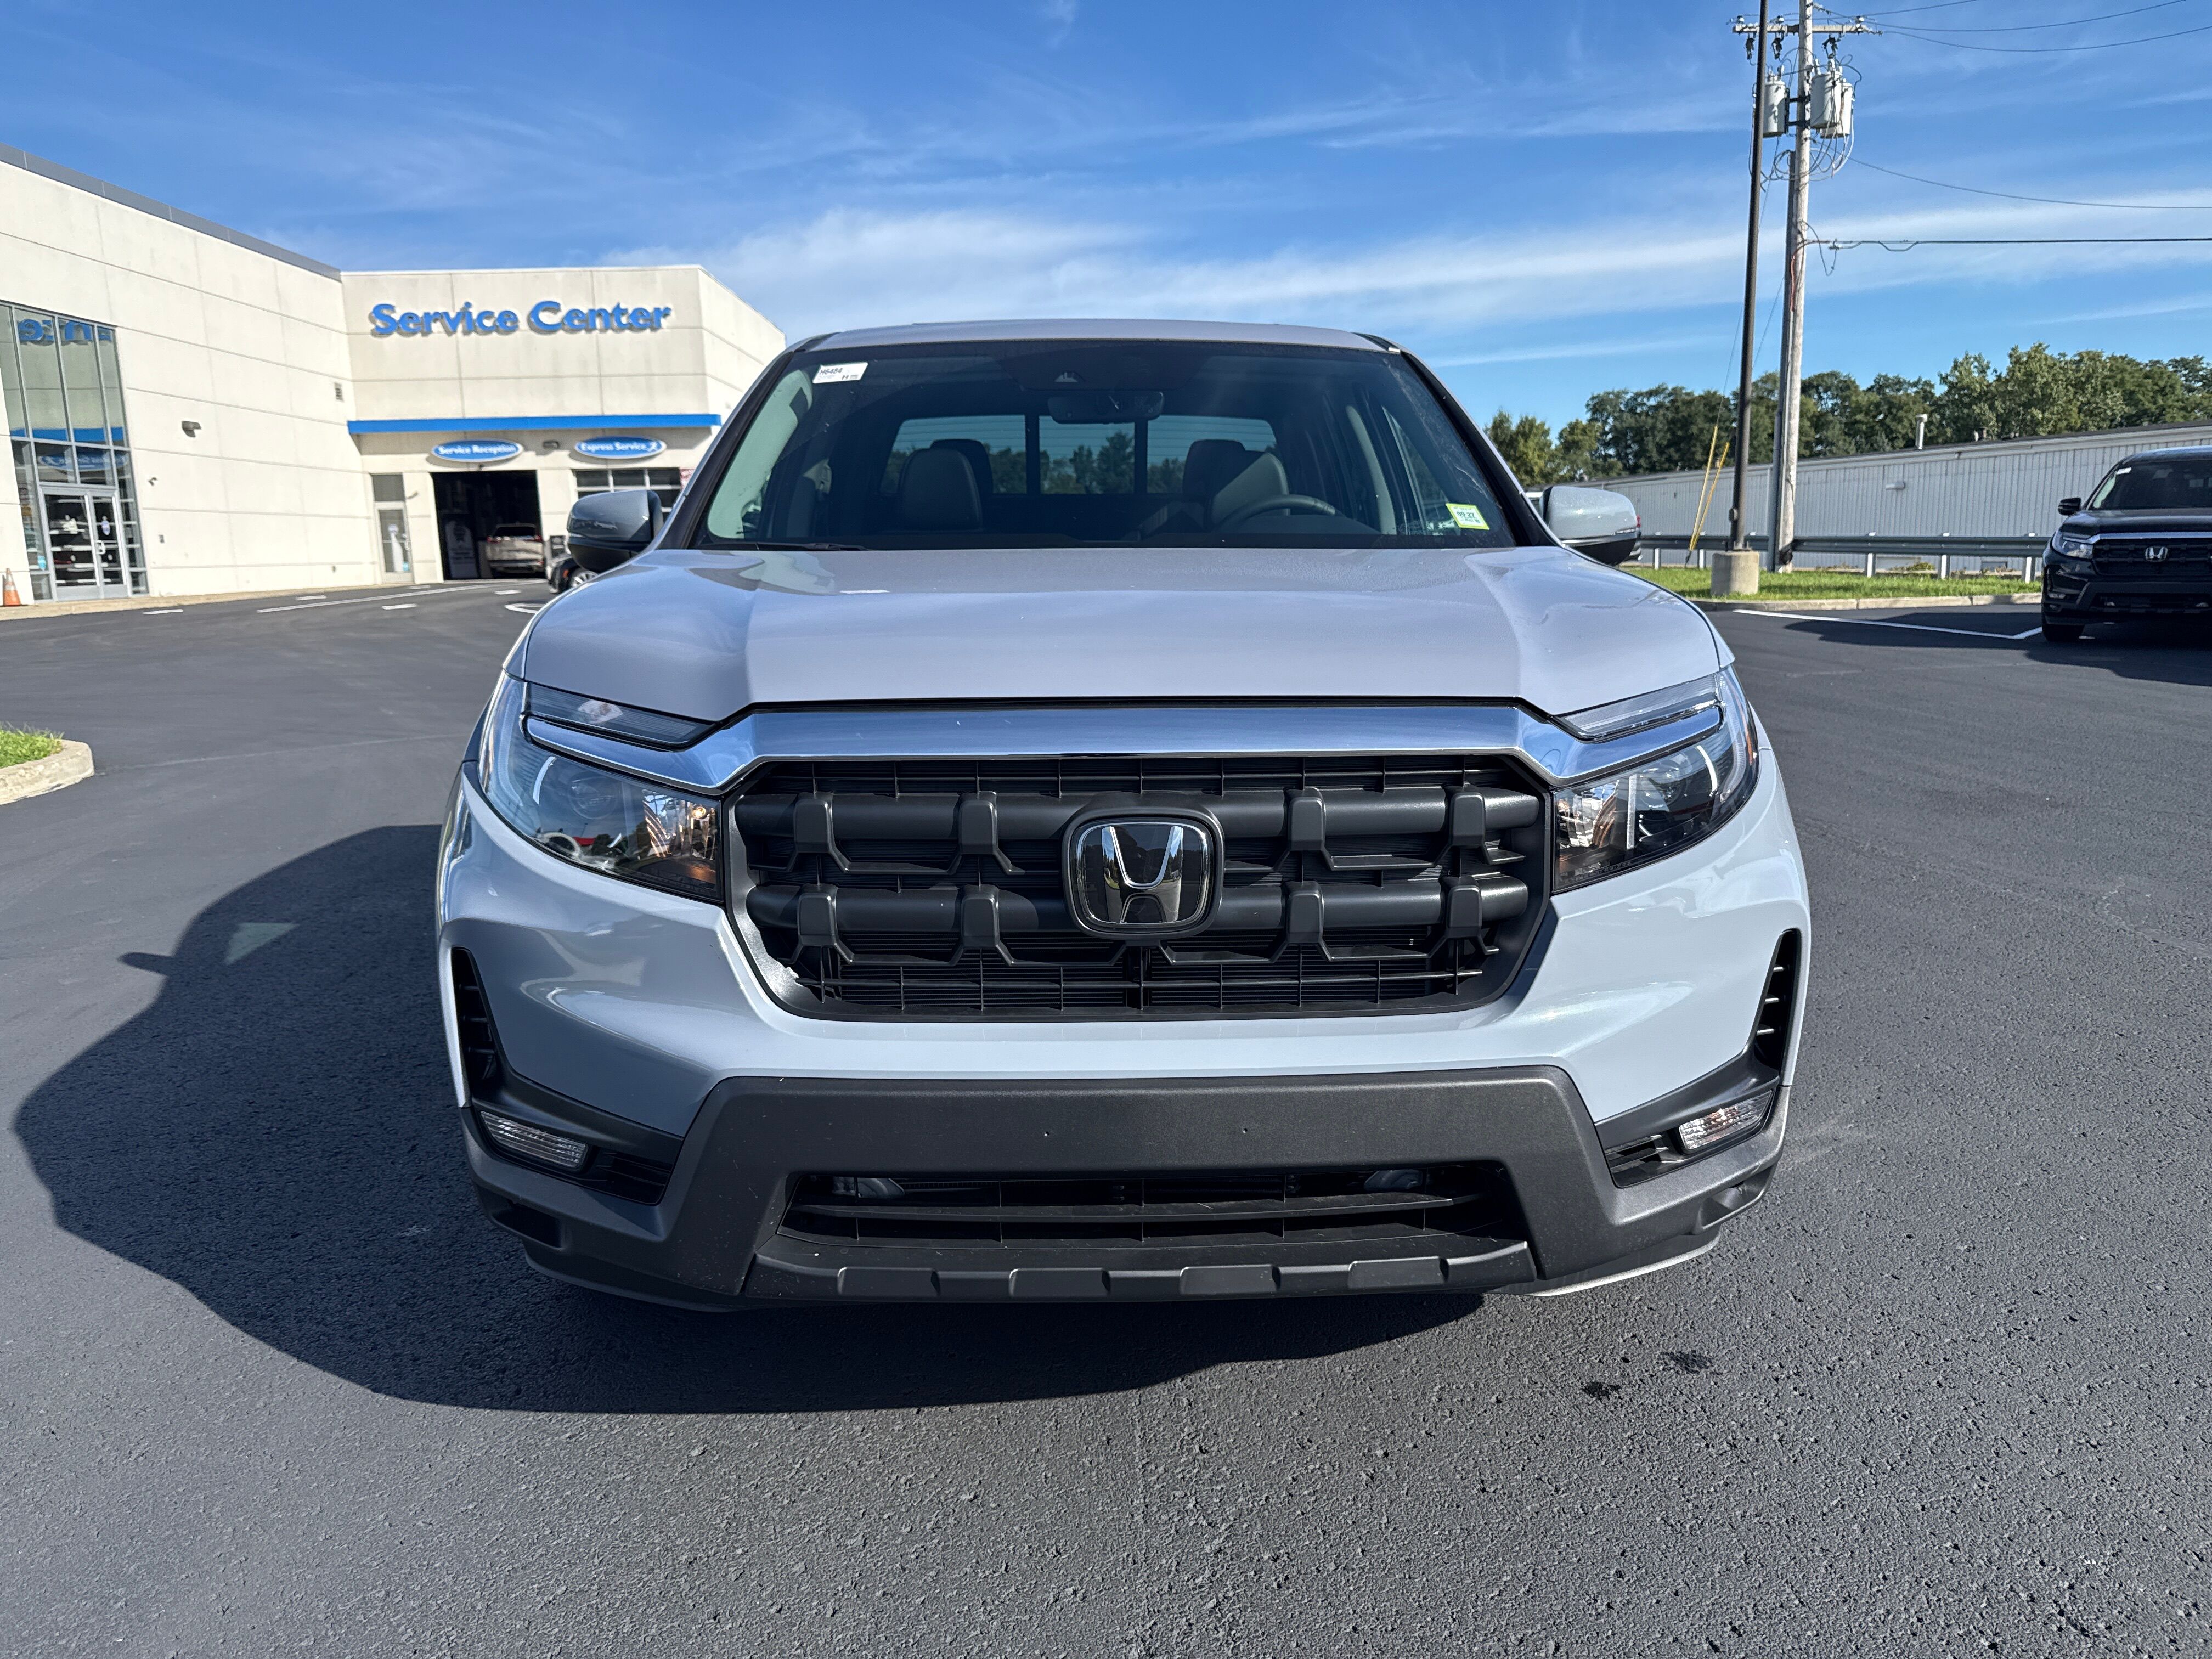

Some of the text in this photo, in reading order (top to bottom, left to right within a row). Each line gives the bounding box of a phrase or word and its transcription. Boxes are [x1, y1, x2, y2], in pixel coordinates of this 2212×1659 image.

[371, 300, 672, 334] Service Center
[438, 444, 516, 455] Service Reception
[580, 441, 646, 453] Express Service
